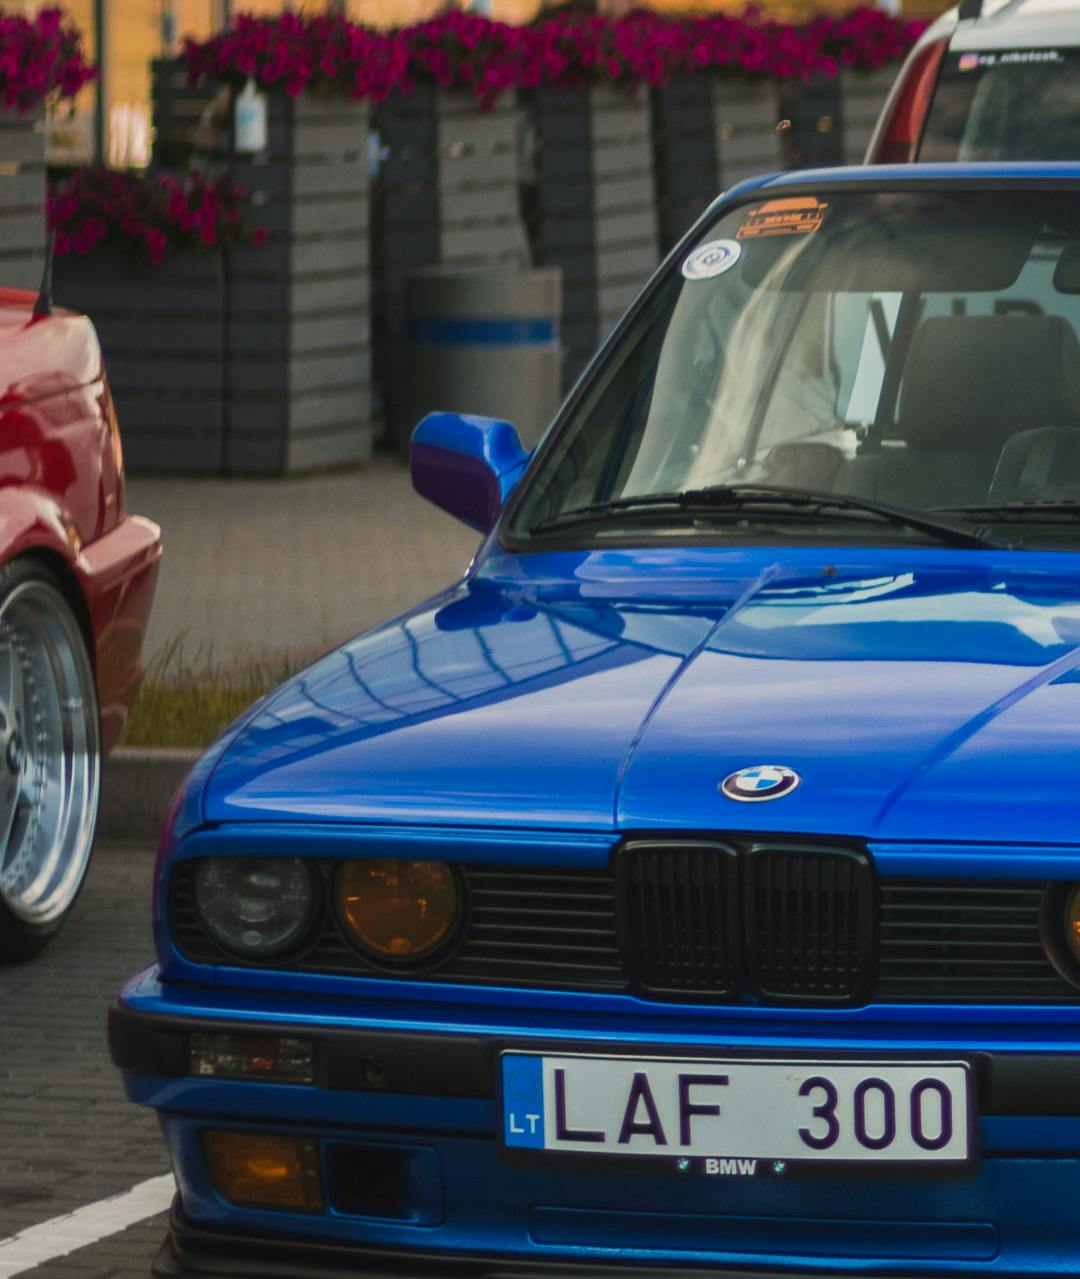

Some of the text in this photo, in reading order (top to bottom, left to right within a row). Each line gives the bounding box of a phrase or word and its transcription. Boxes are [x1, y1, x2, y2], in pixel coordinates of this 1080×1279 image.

[553, 1068, 953, 1150] LAF 300
[509, 1113, 540, 1134] LT
[705, 1158, 757, 1175] BMW
